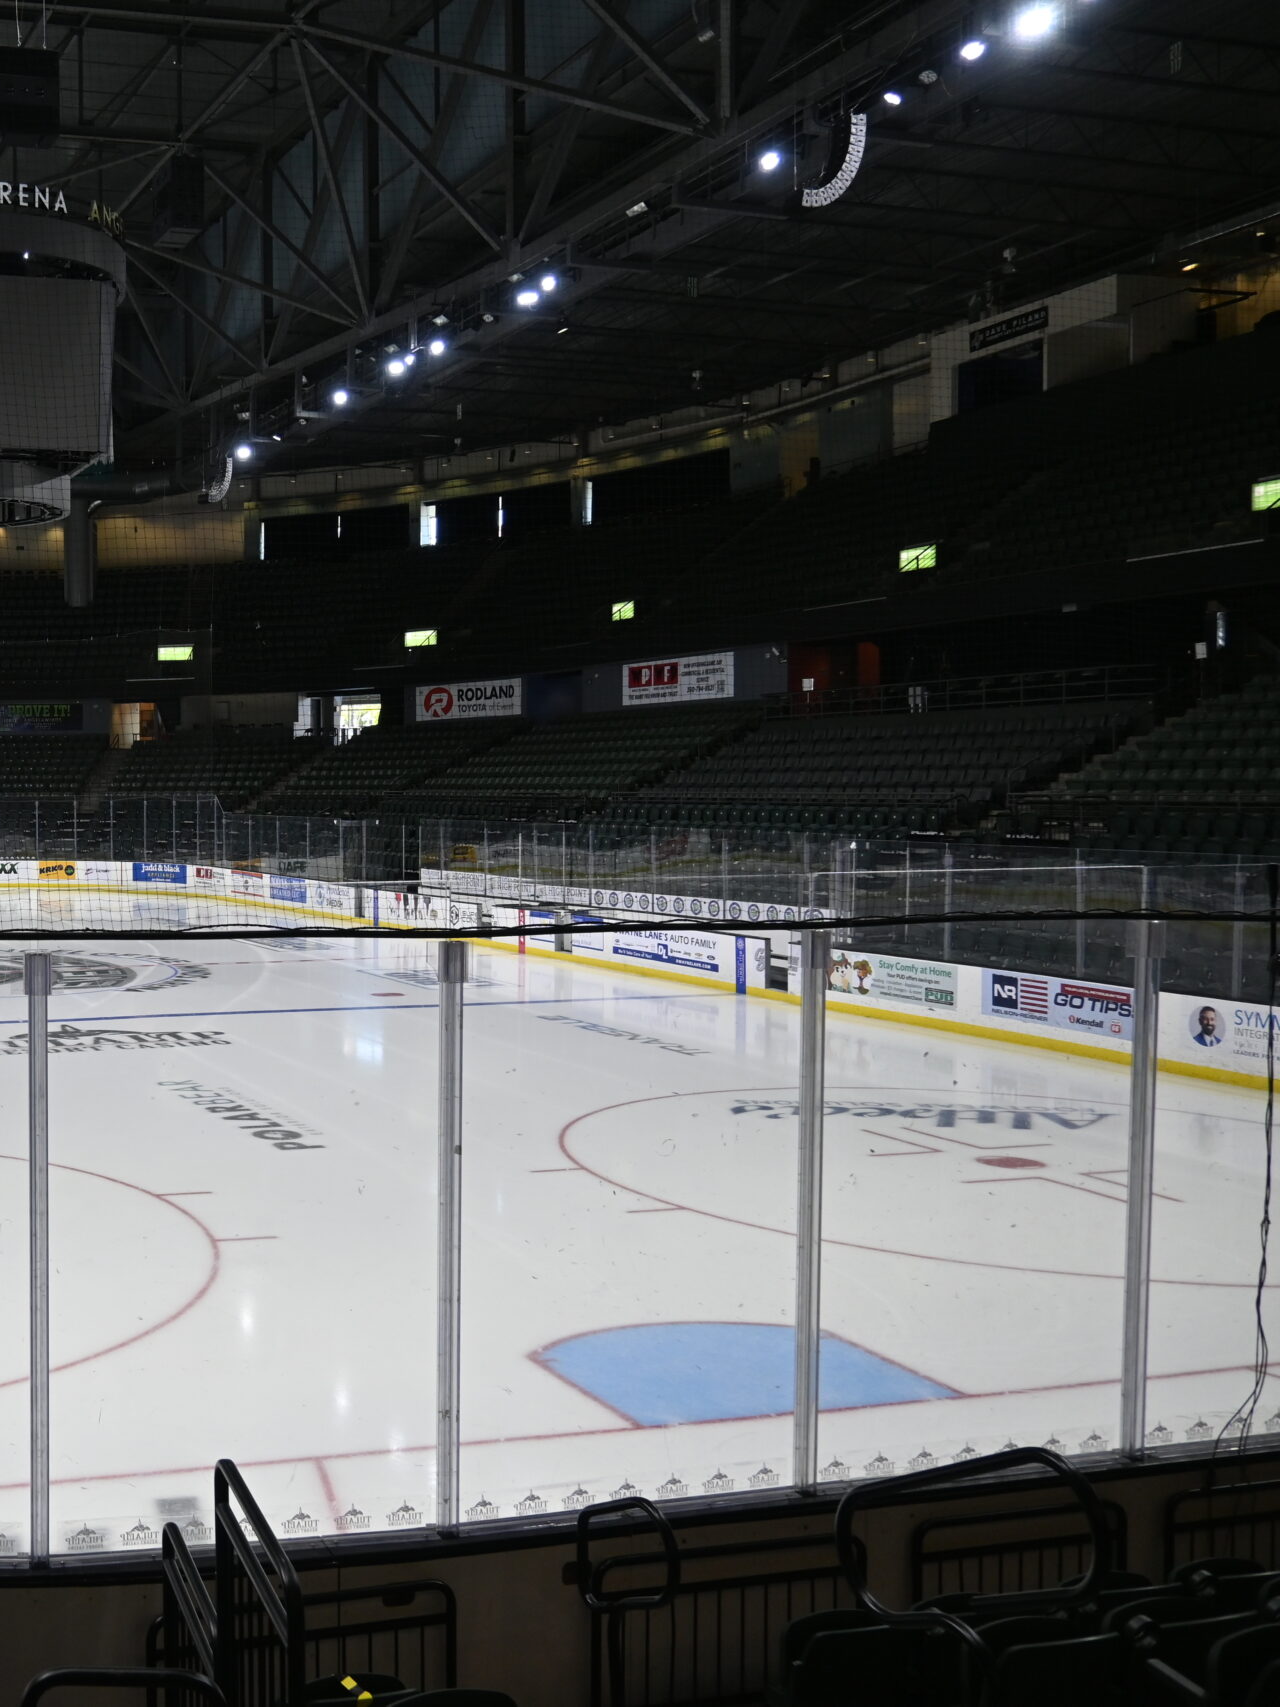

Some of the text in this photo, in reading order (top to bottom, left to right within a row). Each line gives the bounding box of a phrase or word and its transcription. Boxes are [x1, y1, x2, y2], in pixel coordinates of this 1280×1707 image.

[457, 685, 514, 702] RODLAND
[458, 704, 486, 712] TOYOTA
[566, 888, 587, 898] POINT
[645, 932, 668, 941] LANE'S
[670, 935, 689, 944] AUTO
[691, 938, 717, 949] FAMILY
[879, 960, 952, 978] Stay Comfy at Home
[994, 984, 1016, 1000] NR
[1054, 993, 1084, 1009] GO
[992, 1008, 1048, 1022] NELSON-REISNER
[1075, 1017, 1104, 1028] Kendall
[111, 1039, 233, 1050] CASINO
[732, 1099, 901, 1109] SOLUIONS
